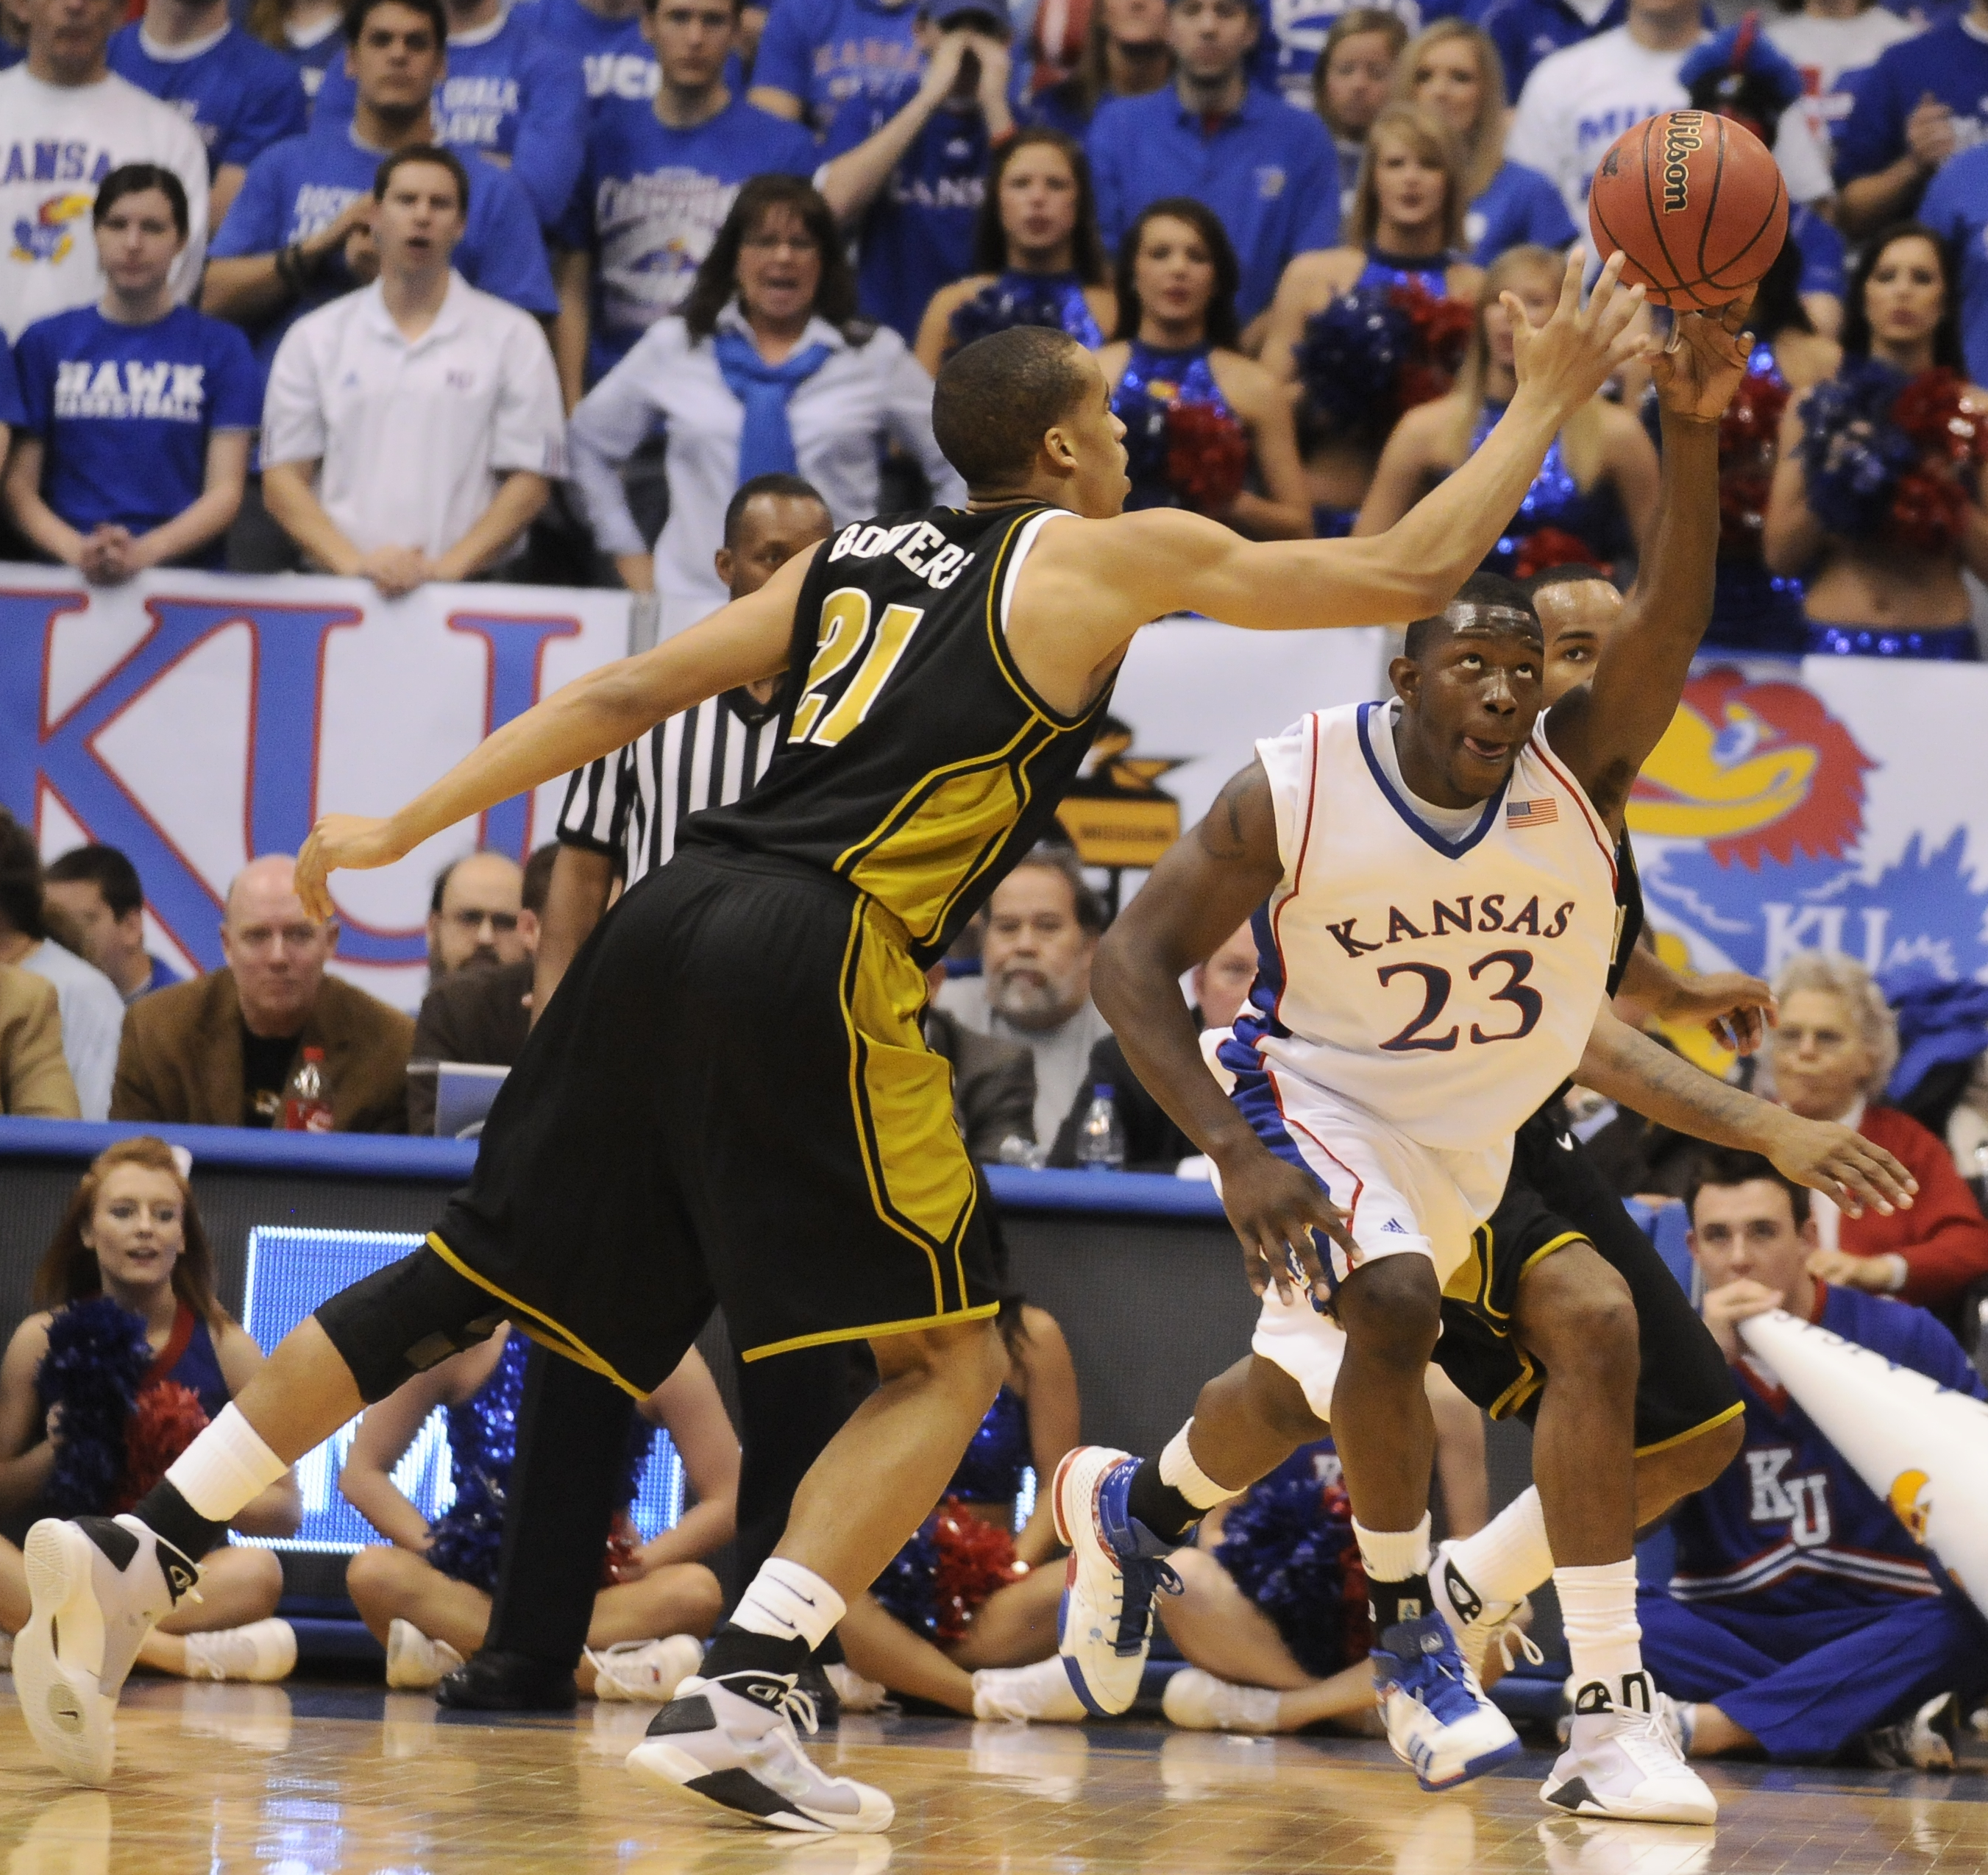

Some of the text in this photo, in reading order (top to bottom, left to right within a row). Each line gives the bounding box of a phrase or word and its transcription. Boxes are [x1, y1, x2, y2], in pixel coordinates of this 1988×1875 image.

[2, 140, 111, 184] ANSA
[1664, 111, 1704, 215] Wilson
[56, 360, 206, 401] HAWK
[787, 586, 925, 747] 21
[0, 591, 583, 971] KU
[1325, 894, 1576, 958] KANSAS
[1761, 902, 1892, 990] KU
[1377, 949, 1544, 1052] 23
[1745, 1447, 1830, 1546] KU
